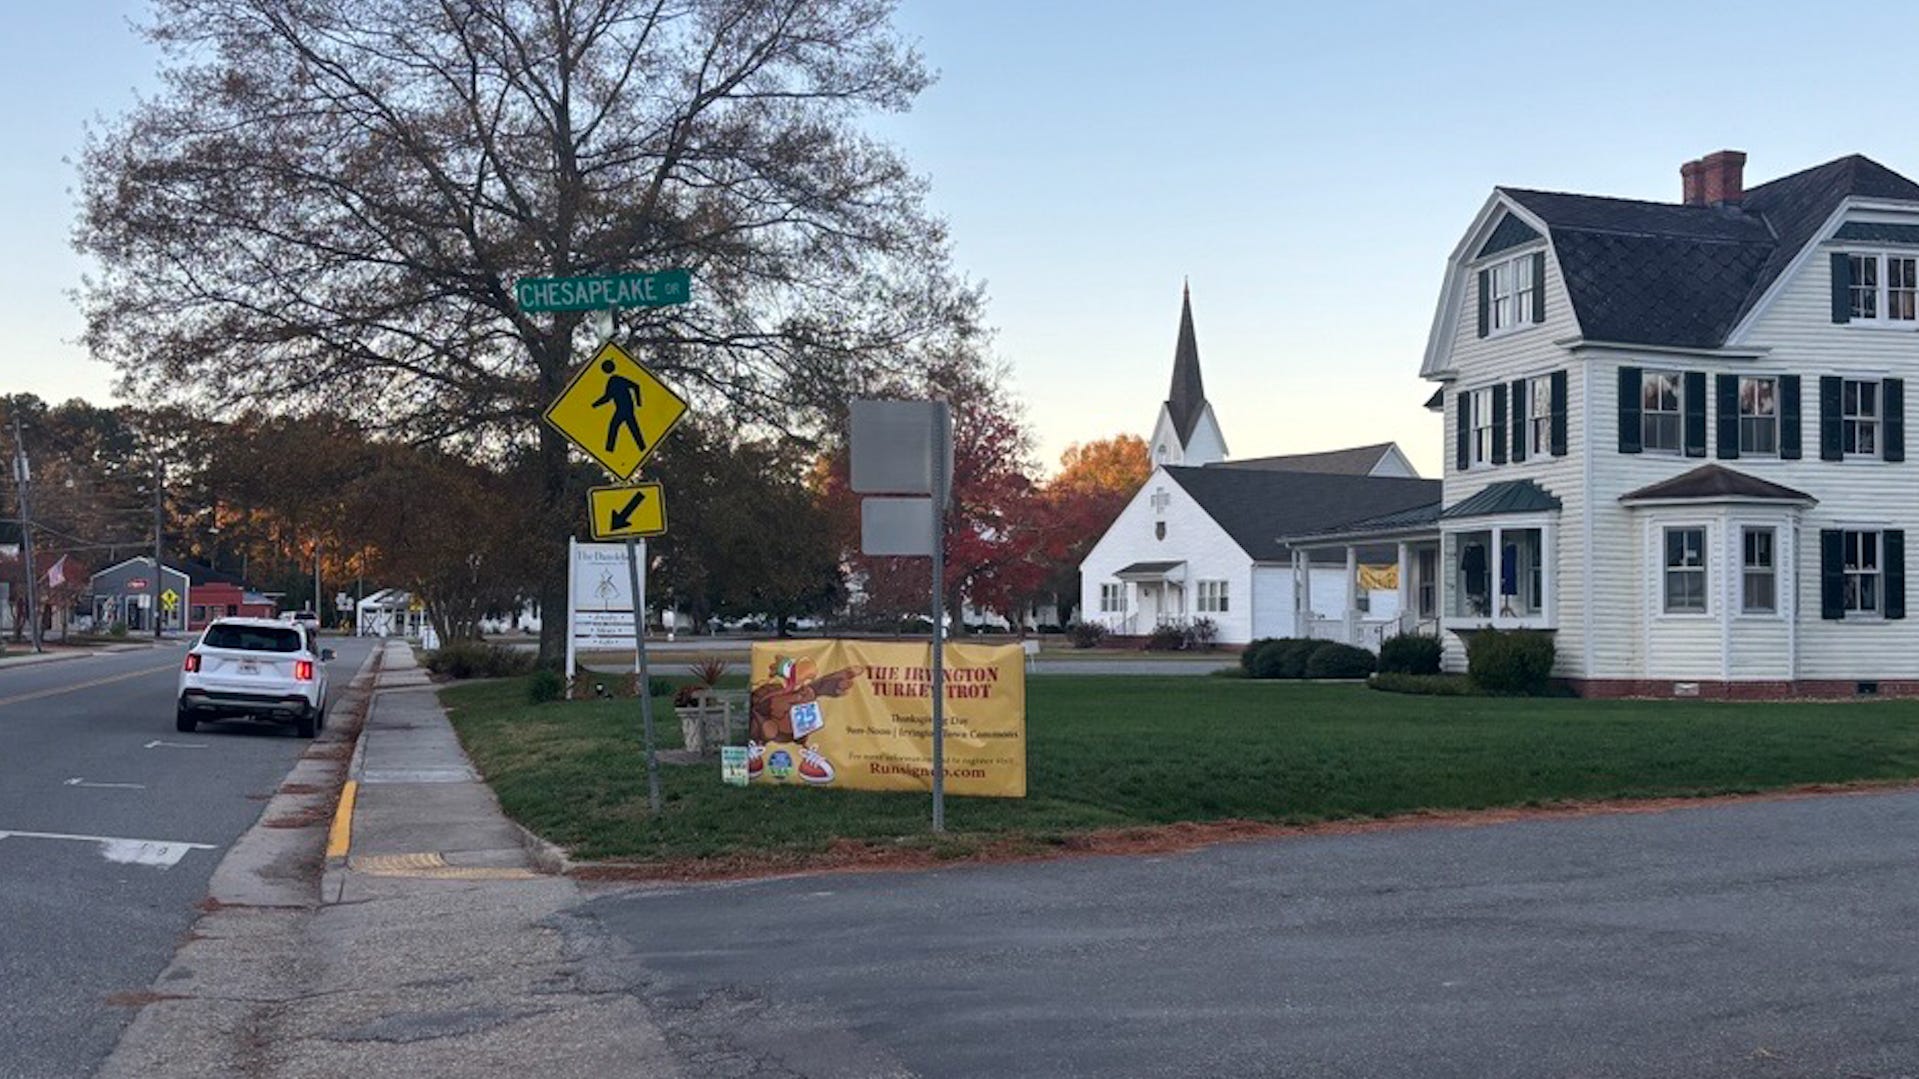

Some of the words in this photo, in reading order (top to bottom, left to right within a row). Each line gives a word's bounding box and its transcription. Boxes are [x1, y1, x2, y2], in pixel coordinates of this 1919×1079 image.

[520, 277, 658, 308] CHESAPEAKE
[866, 666, 899, 681] THE
[904, 666, 1000, 682] IRVNGTON
[872, 682, 935, 698] TURKE
[946, 683, 992, 699] TROT
[950, 717, 968, 727] Day
[970, 730, 1018, 738] Commons
